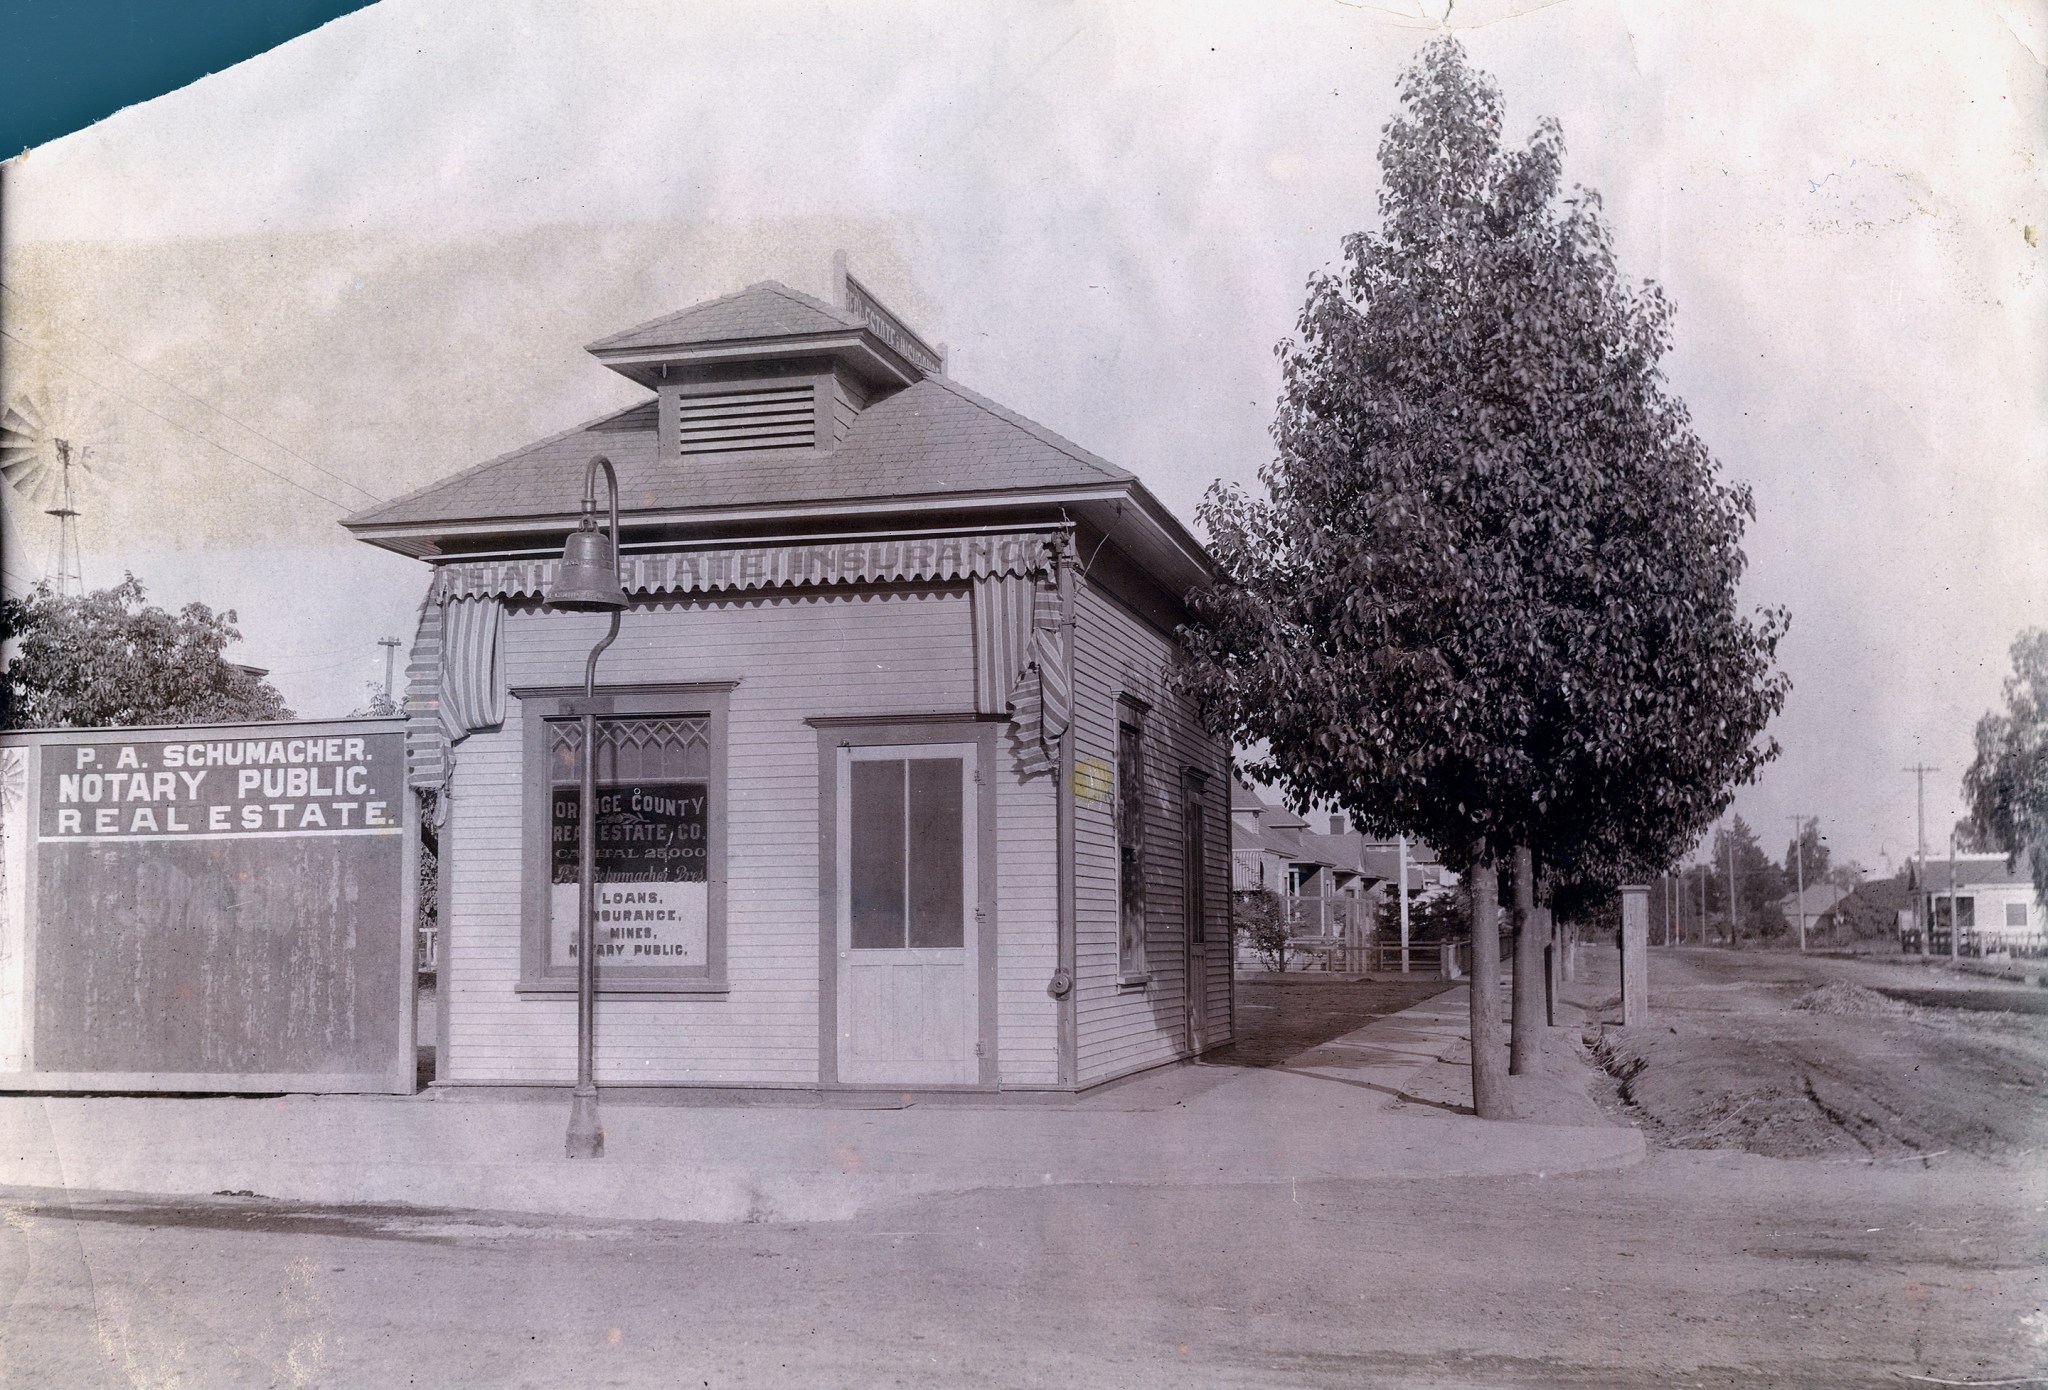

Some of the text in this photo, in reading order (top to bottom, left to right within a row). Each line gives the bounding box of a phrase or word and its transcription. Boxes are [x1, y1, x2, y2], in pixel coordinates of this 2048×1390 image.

[77, 738, 373, 769] P. A. SCHUMACHER.
[59, 766, 376, 803] NOTARY PUBLIC.
[555, 794, 705, 819] ORGE COUNTY
[58, 801, 395, 834] REAL ESTATE.
[553, 823, 706, 842] REA ESTATE CO.
[555, 848, 640, 859] CAITAL
[602, 892, 664, 905] LOANS,
[593, 909, 682, 922] NSURANCE,
[610, 927, 658, 940] MINES,
[569, 944, 688, 958] NARY PUBLIC.
